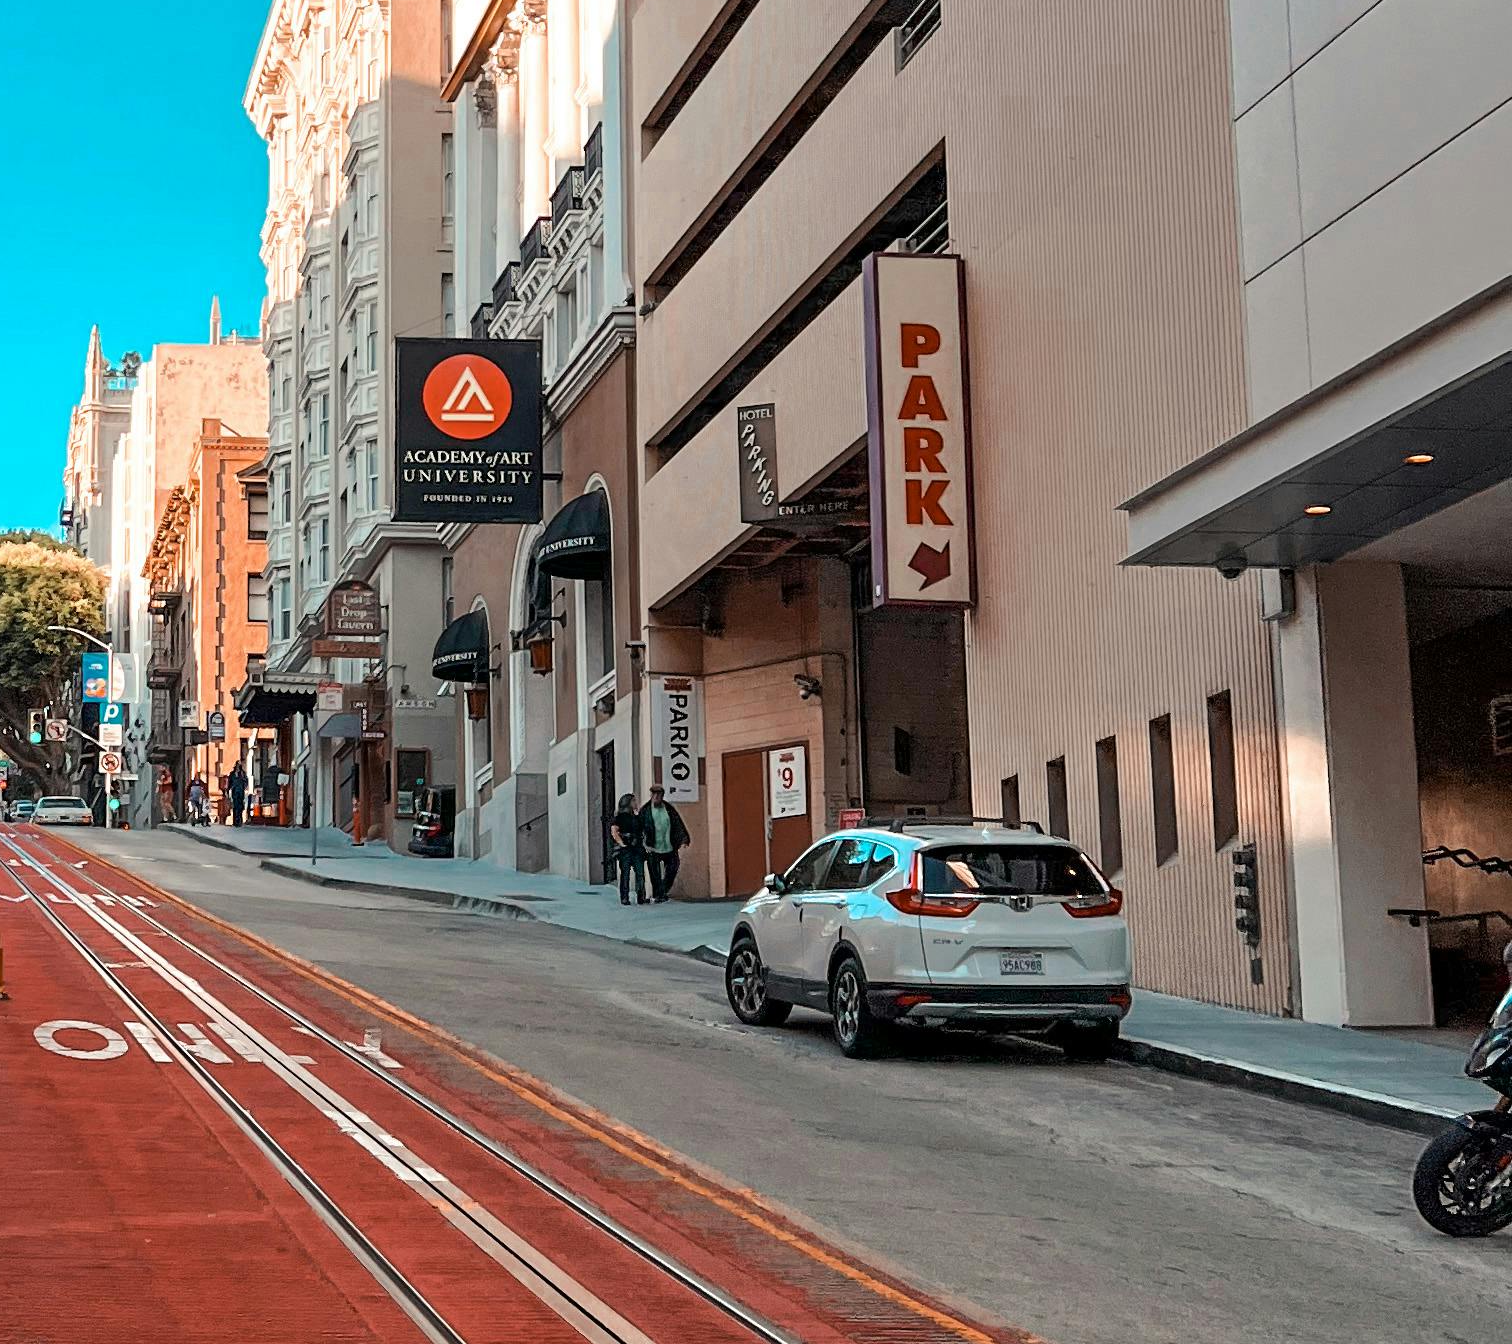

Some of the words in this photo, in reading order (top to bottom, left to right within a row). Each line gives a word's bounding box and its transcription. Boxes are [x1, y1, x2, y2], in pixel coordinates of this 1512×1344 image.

[739, 408, 773, 422] HOTEL
[898, 323, 954, 526] PARK
[404, 451, 485, 465] ACADEMY
[485, 452, 500, 468] of
[500, 452, 534, 465] ART
[740, 424, 775, 506] PARKING
[403, 469, 533, 484] UNIVERSITY
[423, 494, 472, 503] FOUNDED
[476, 495, 487, 503] IN
[778, 504, 816, 516] ENTER
[819, 501, 849, 513] HERE
[546, 536, 596, 554] UNIVERSITY
[341, 606, 367, 619] Drop
[336, 618, 374, 630] Tavern
[669, 694, 690, 760] PARK
